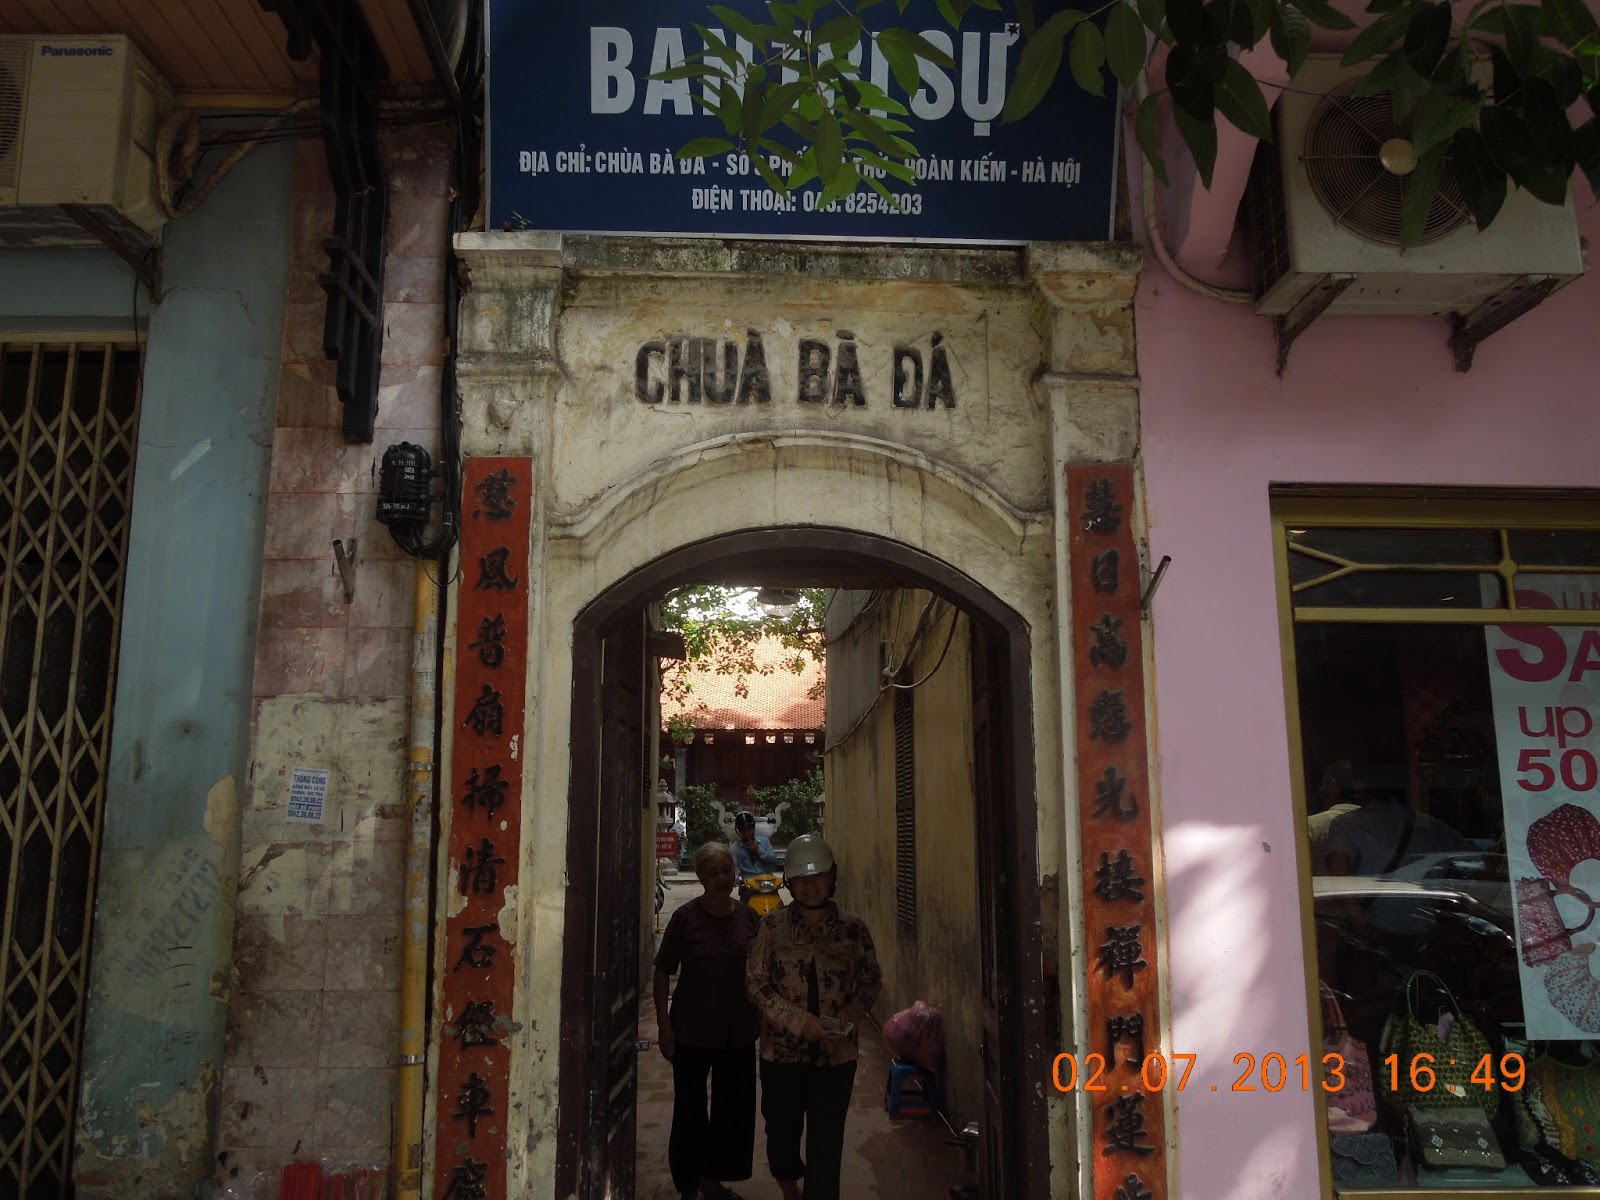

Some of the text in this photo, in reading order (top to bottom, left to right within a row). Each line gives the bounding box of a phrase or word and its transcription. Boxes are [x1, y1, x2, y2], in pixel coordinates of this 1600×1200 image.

[41, 45, 114, 57] Panasonic
[519, 151, 549, 176] ĐỊA
[555, 144, 592, 174] CHỈ:
[595, 147, 644, 174] CHÙA
[649, 149, 675, 175] BÀ
[960, 152, 1006, 182] KIẾM
[1022, 157, 1046, 183] HÀ
[1051, 157, 1081, 188] NỘI
[691, 184, 733, 214] ĐIỆN
[740, 190, 797, 215] THOẠI:
[798, 329, 866, 406] BÀ
[1518, 706, 1593, 749] up
[1517, 749, 1598, 792] 50
